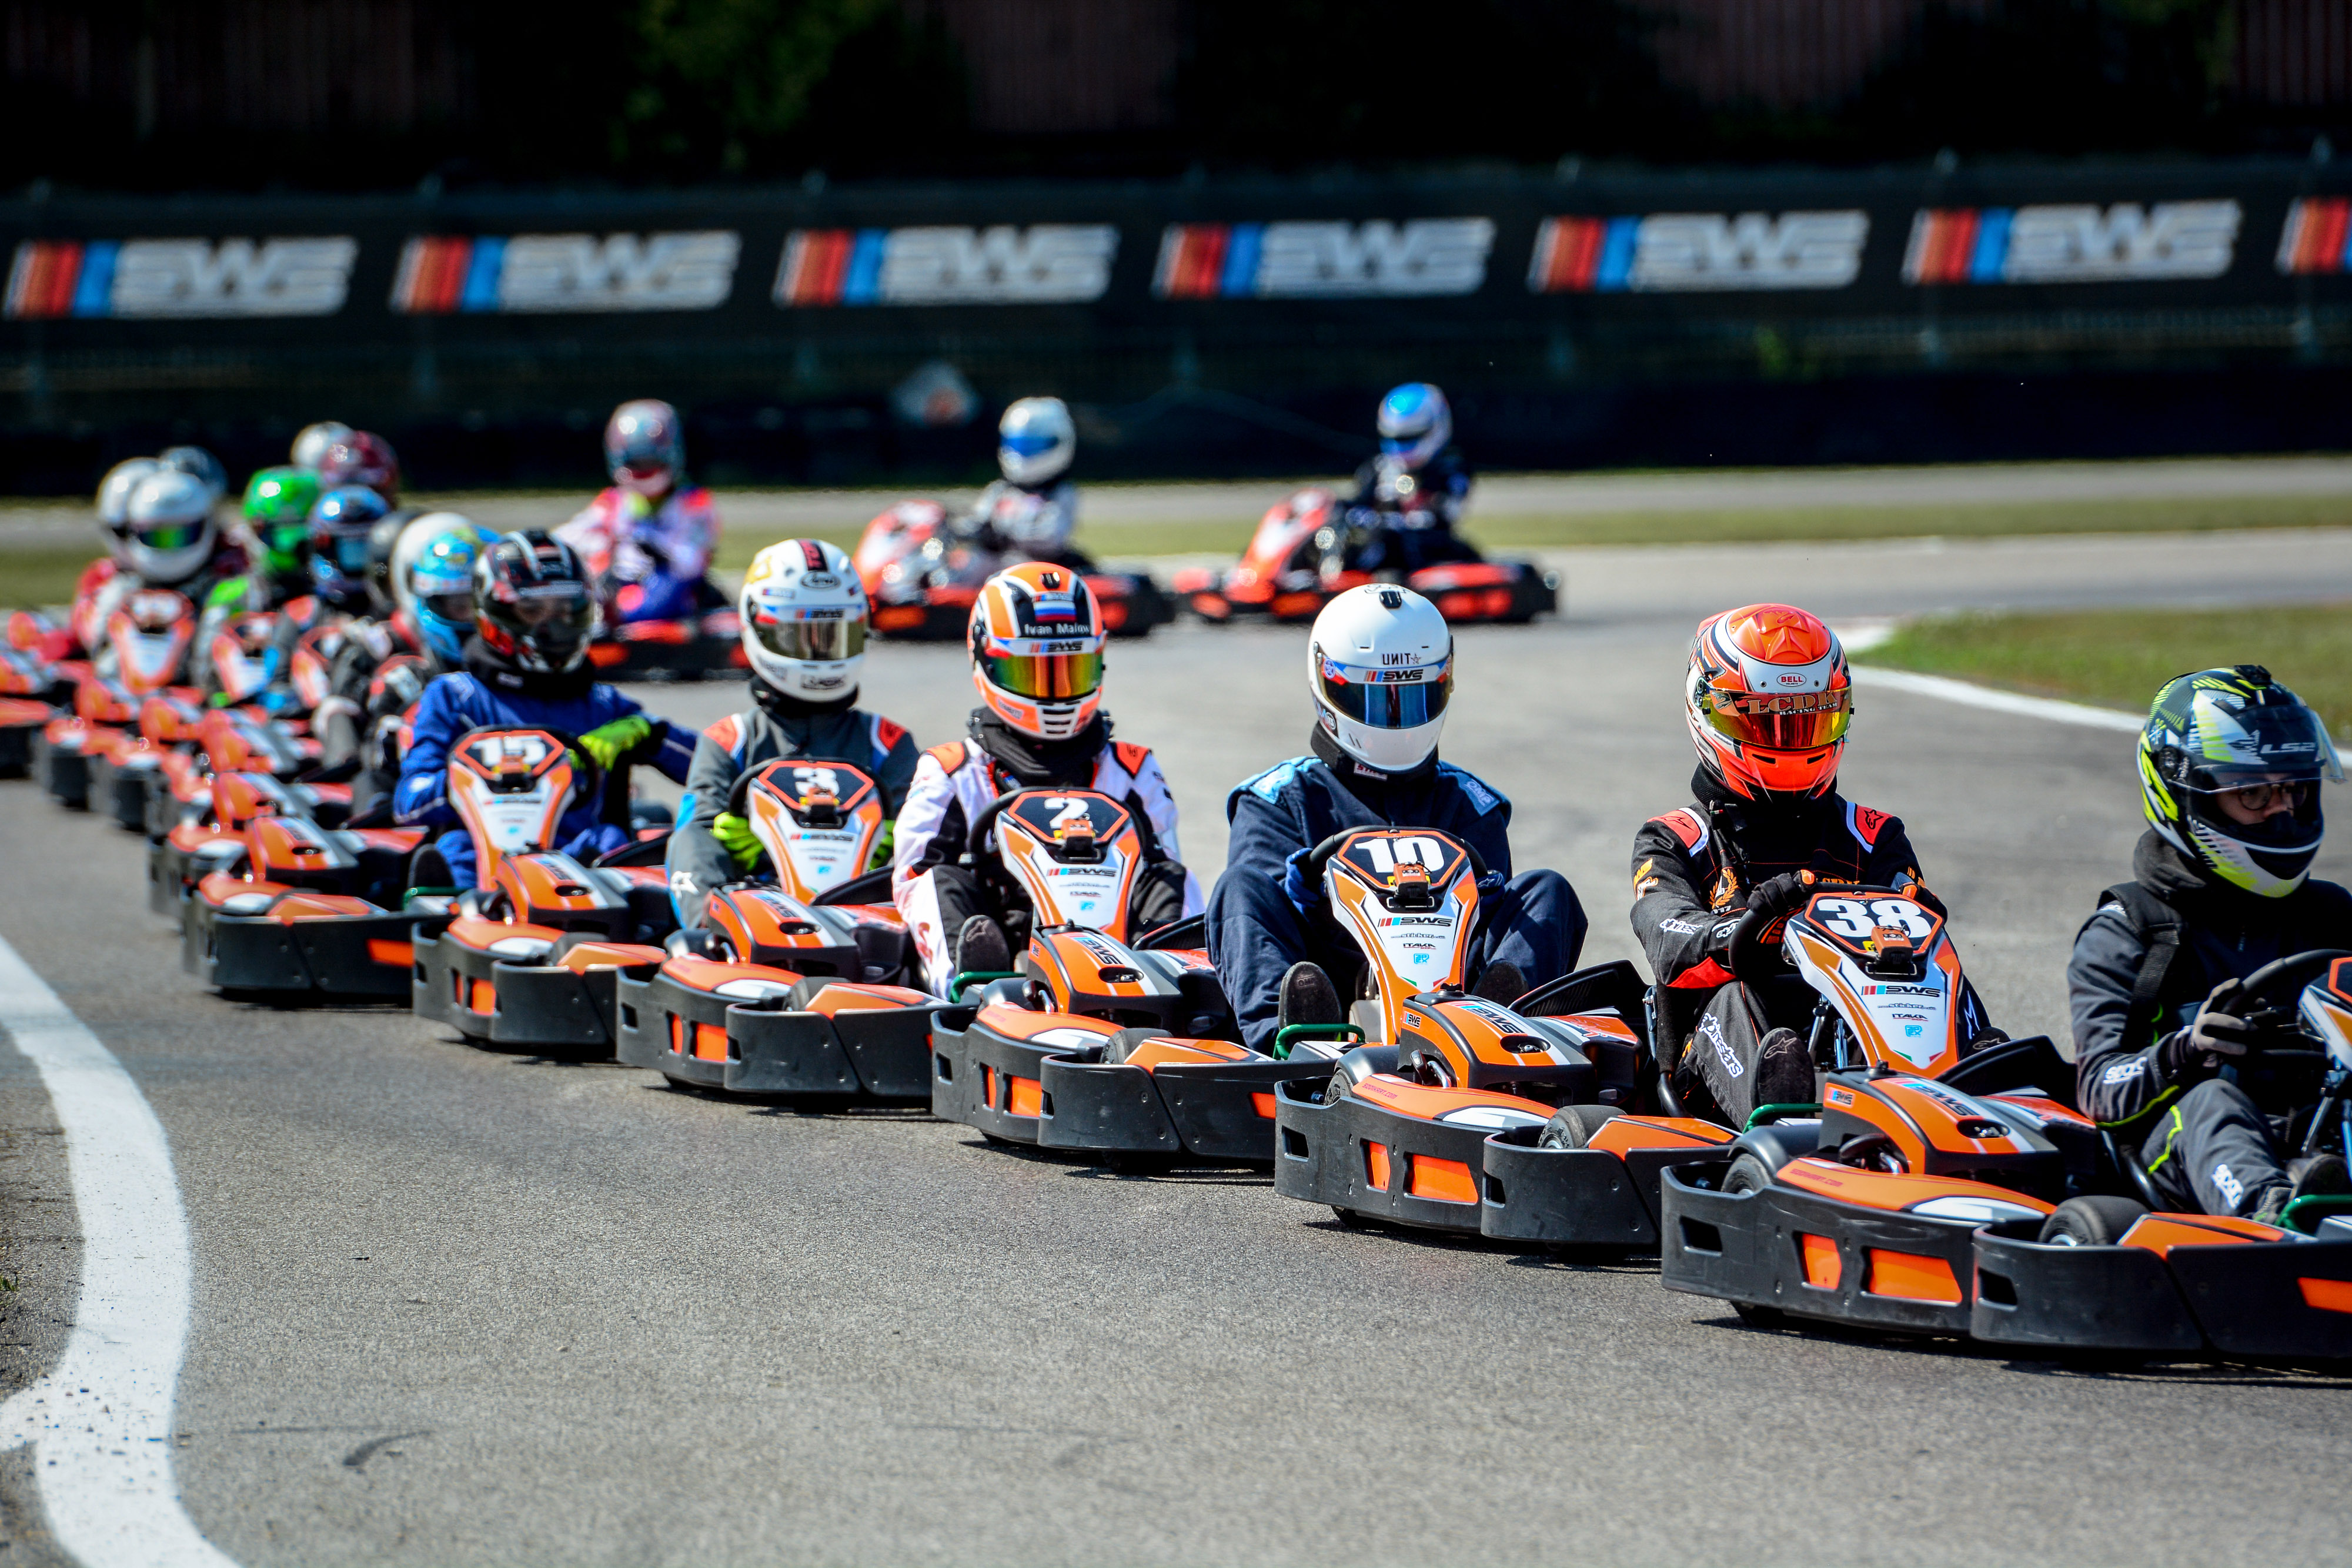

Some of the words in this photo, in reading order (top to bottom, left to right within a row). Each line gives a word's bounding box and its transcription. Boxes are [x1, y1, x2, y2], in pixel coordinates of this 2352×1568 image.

[1628, 210, 1871, 291] SWS
[2005, 198, 2241, 284] SWS
[880, 223, 1120, 305] SWS
[1252, 217, 1496, 296] SWS
[111, 238, 359, 319] SWS
[497, 232, 741, 312] SWS
[1024, 624, 1053, 634] Ivan
[1047, 641, 1083, 653] SWS
[1382, 653, 1411, 665] UNIT
[1382, 669, 1424, 682] SWS
[1748, 692, 1838, 714] LCDK
[1779, 707, 1816, 716] RACING
[1818, 702, 1838, 710] TEAM
[471, 735, 546, 767] 15
[2260, 742, 2316, 754] LS2
[793, 767, 840, 795] 3
[1044, 797, 1094, 828] 2
[1355, 837, 1445, 874] 10
[1068, 868, 1117, 877] SWS
[1400, 917, 1452, 927] SWS
[1816, 899, 1932, 938] 38
[1885, 985, 1940, 998] SWS
[1408, 1014, 1421, 1028] SWS
[1469, 1008, 1525, 1034] SWS
